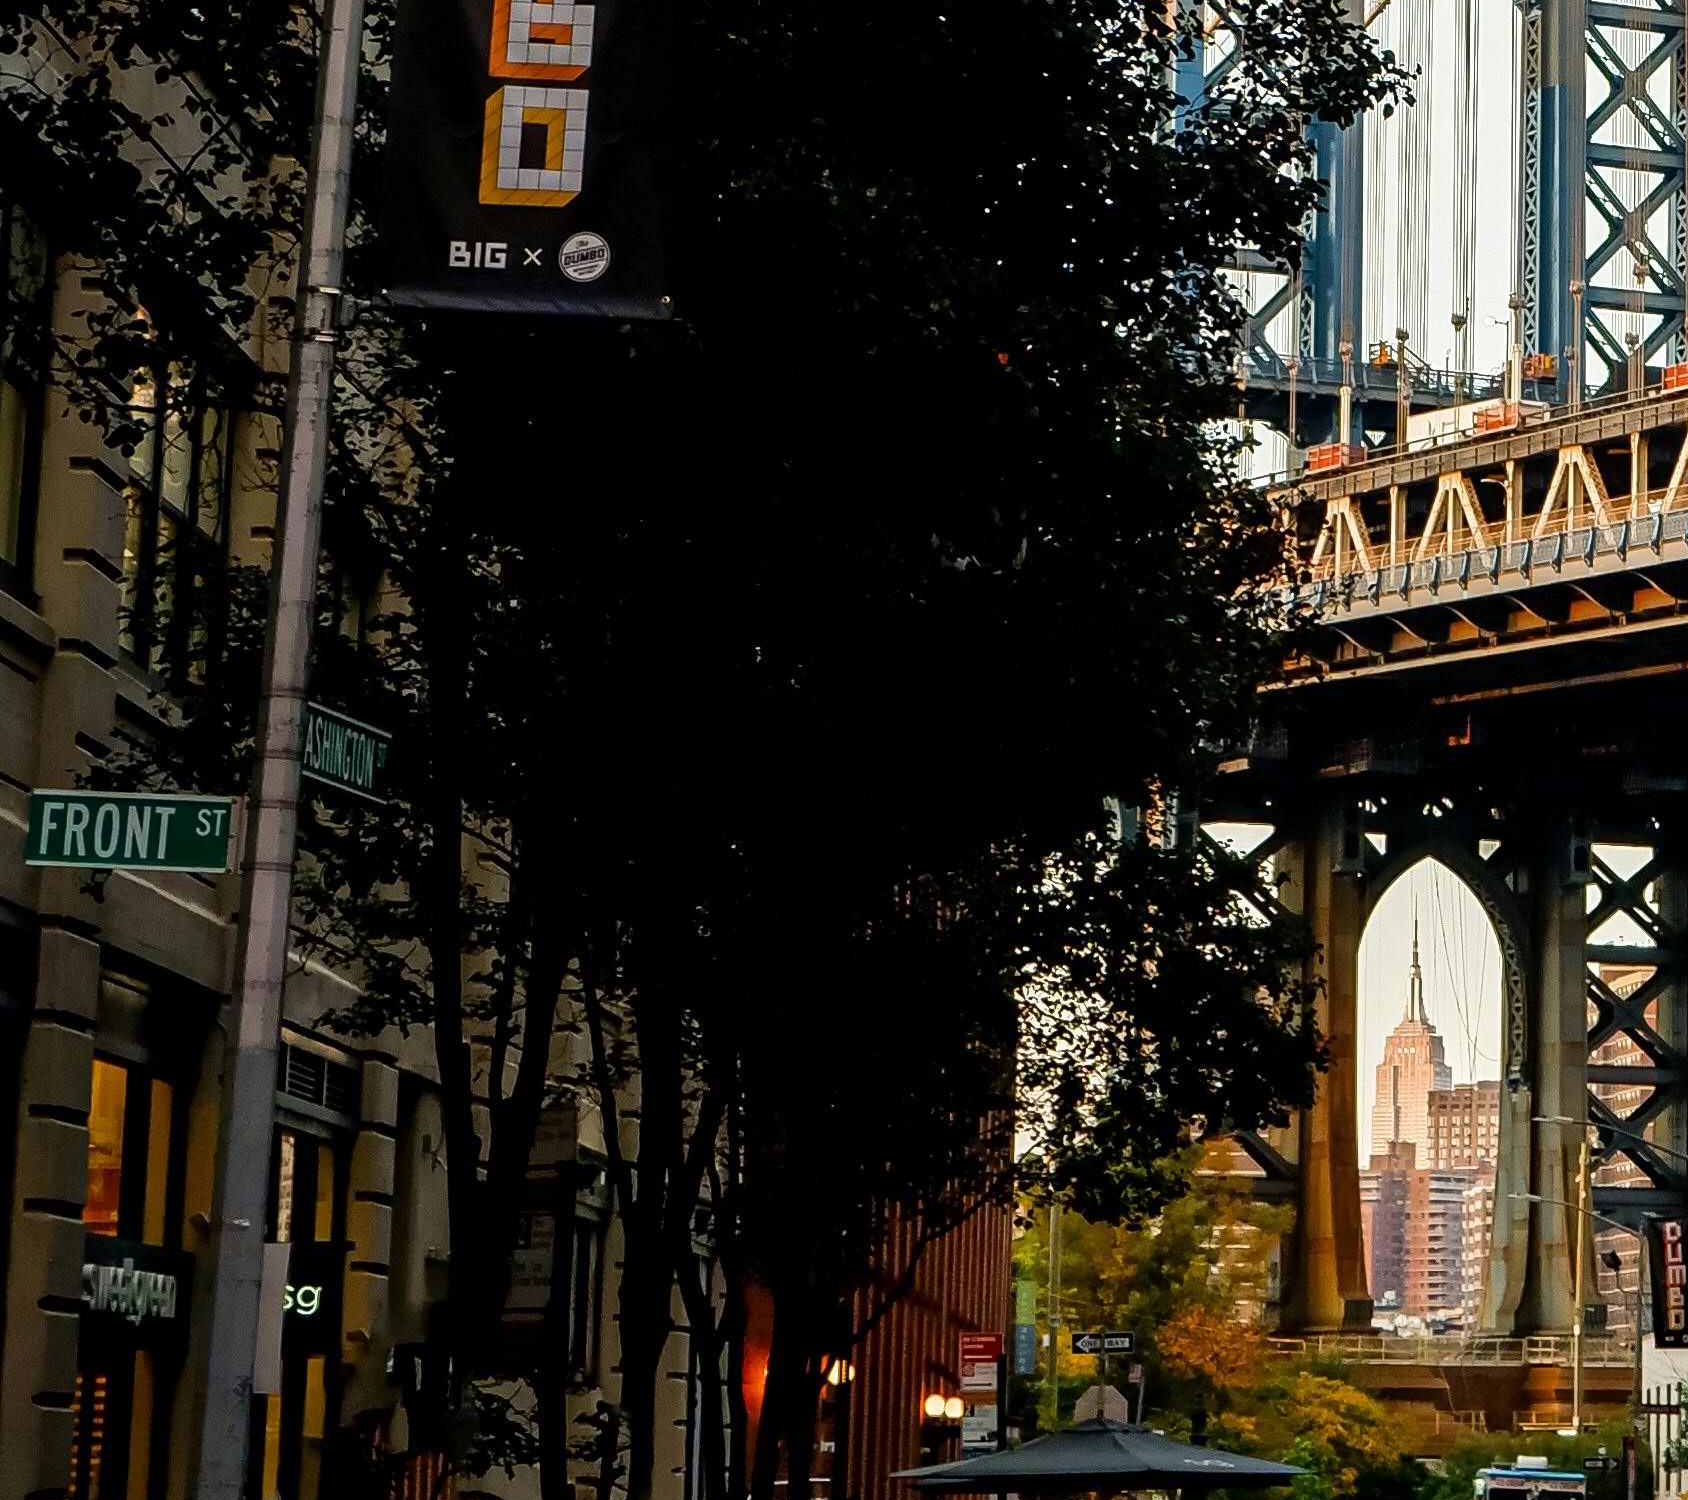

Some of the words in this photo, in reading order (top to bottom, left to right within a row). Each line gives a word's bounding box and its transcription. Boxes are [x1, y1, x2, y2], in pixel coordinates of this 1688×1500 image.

[449, 240, 508, 269] BIG
[563, 249, 606, 266] DUMBO
[303, 713, 376, 789] ASHINGTON
[39, 801, 176, 860] FRONT
[195, 808, 227, 838] ST
[1663, 1221, 1687, 1331] DUMBO
